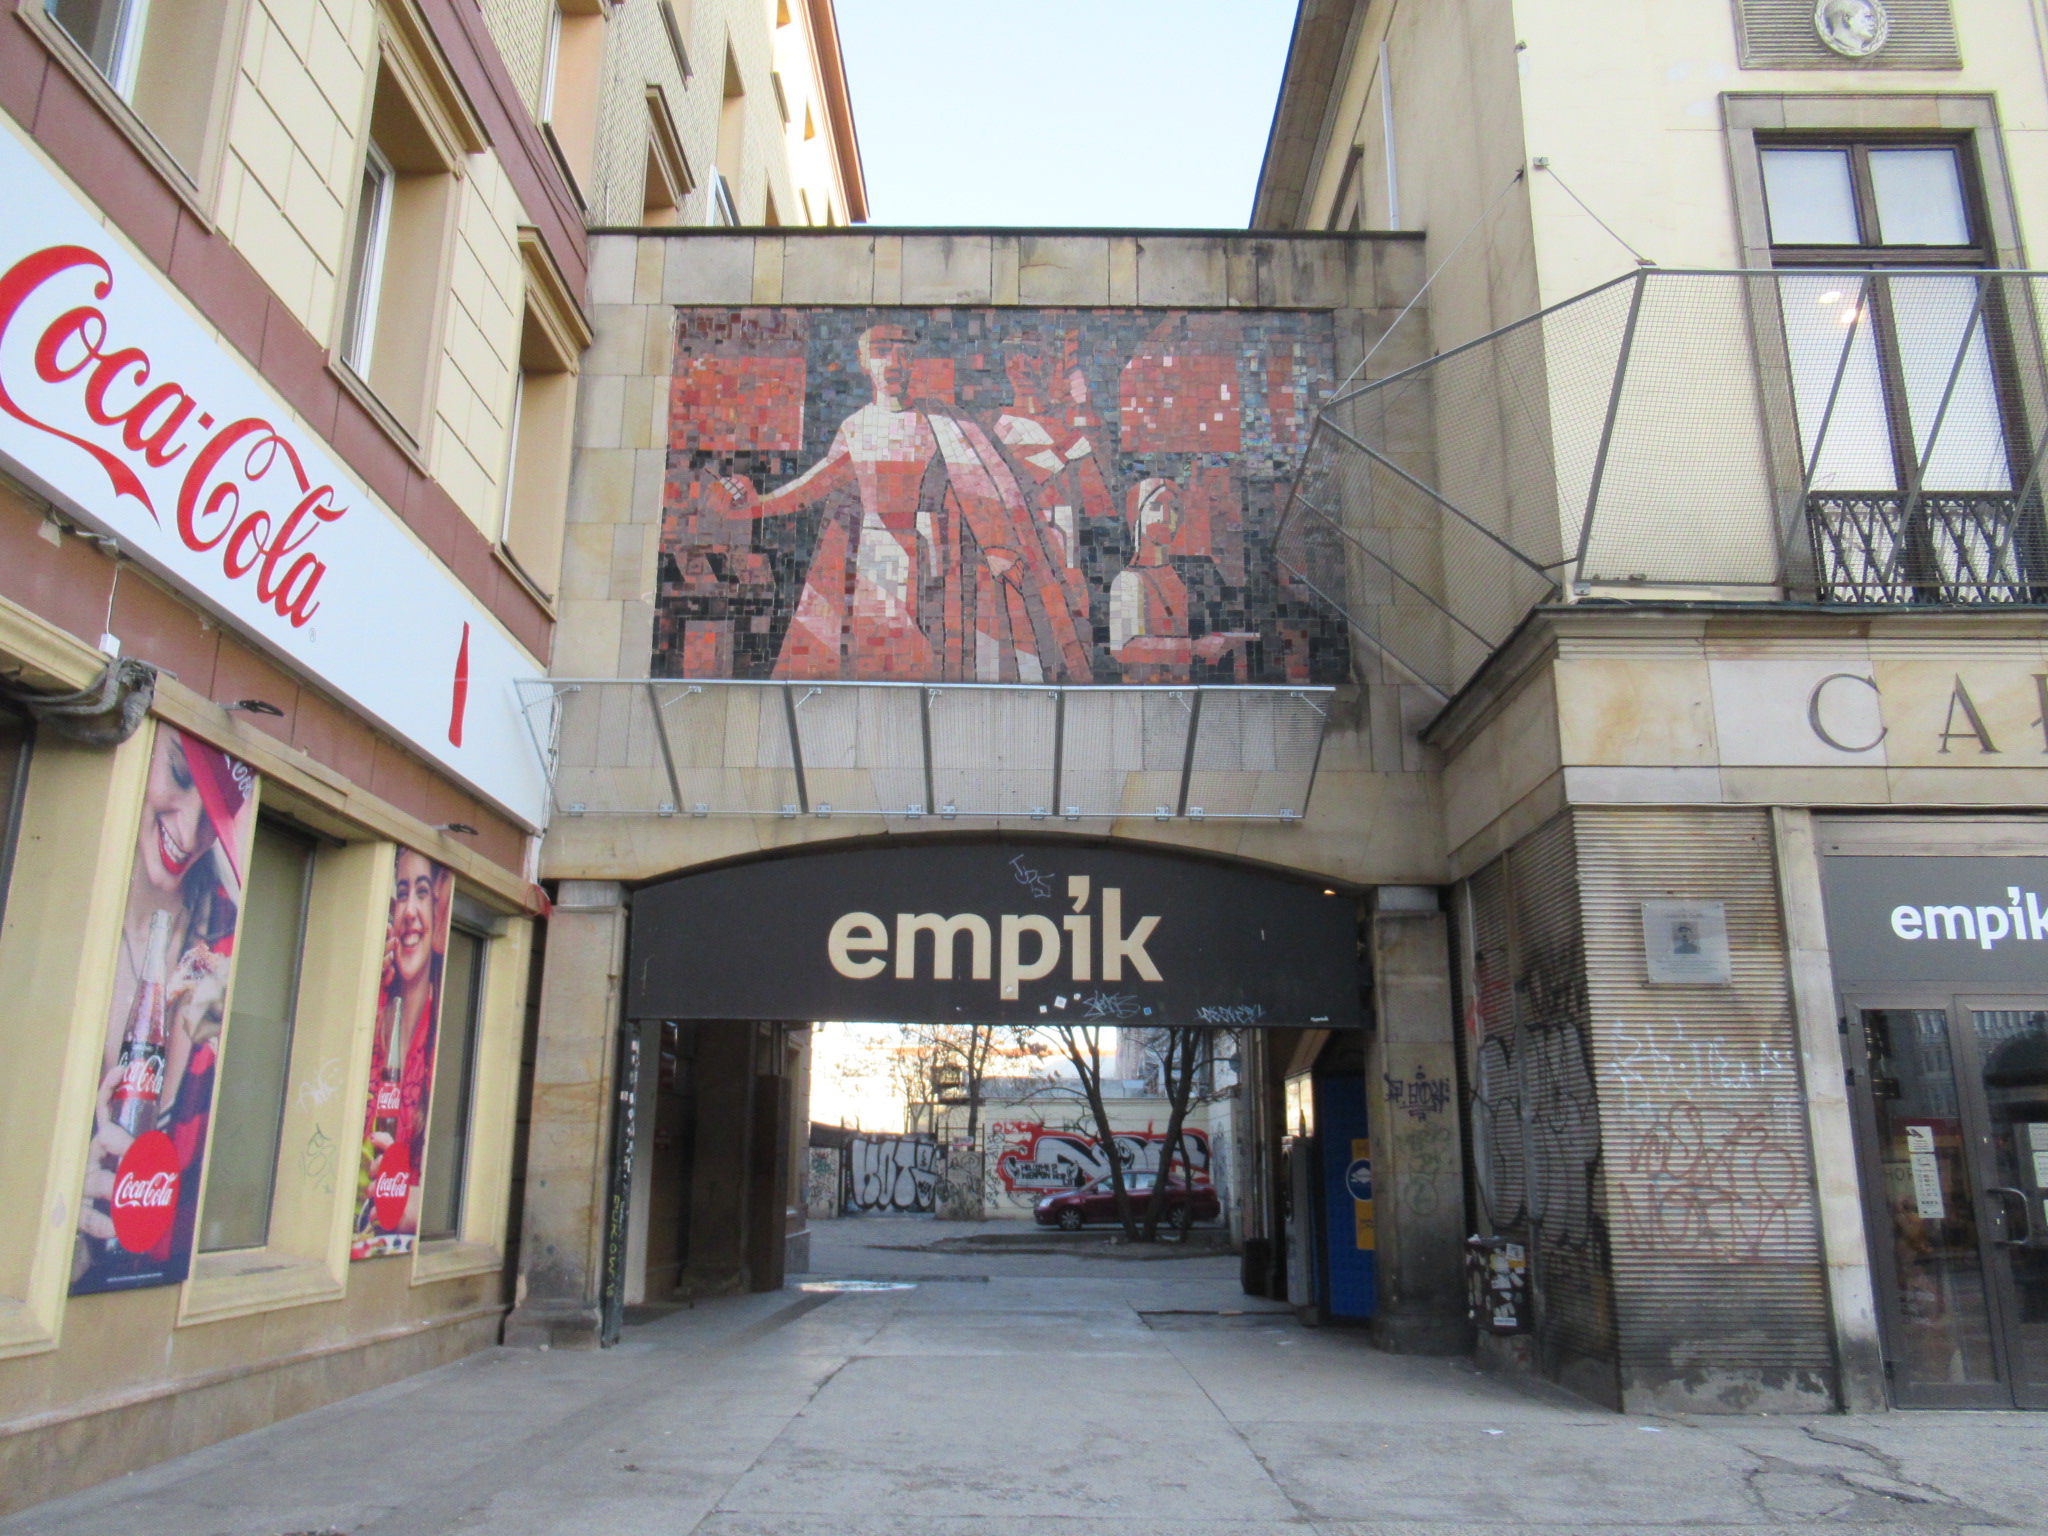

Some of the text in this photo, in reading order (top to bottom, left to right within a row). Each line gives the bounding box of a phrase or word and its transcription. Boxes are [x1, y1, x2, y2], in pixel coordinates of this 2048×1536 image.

[0, 245, 350, 628] Coca-Cola
[828, 875, 1163, 1000] empik
[1891, 886, 2048, 950] empik
[114, 1172, 178, 1209] Coca-Cola
[376, 1171, 410, 1198] Coca-Cola
